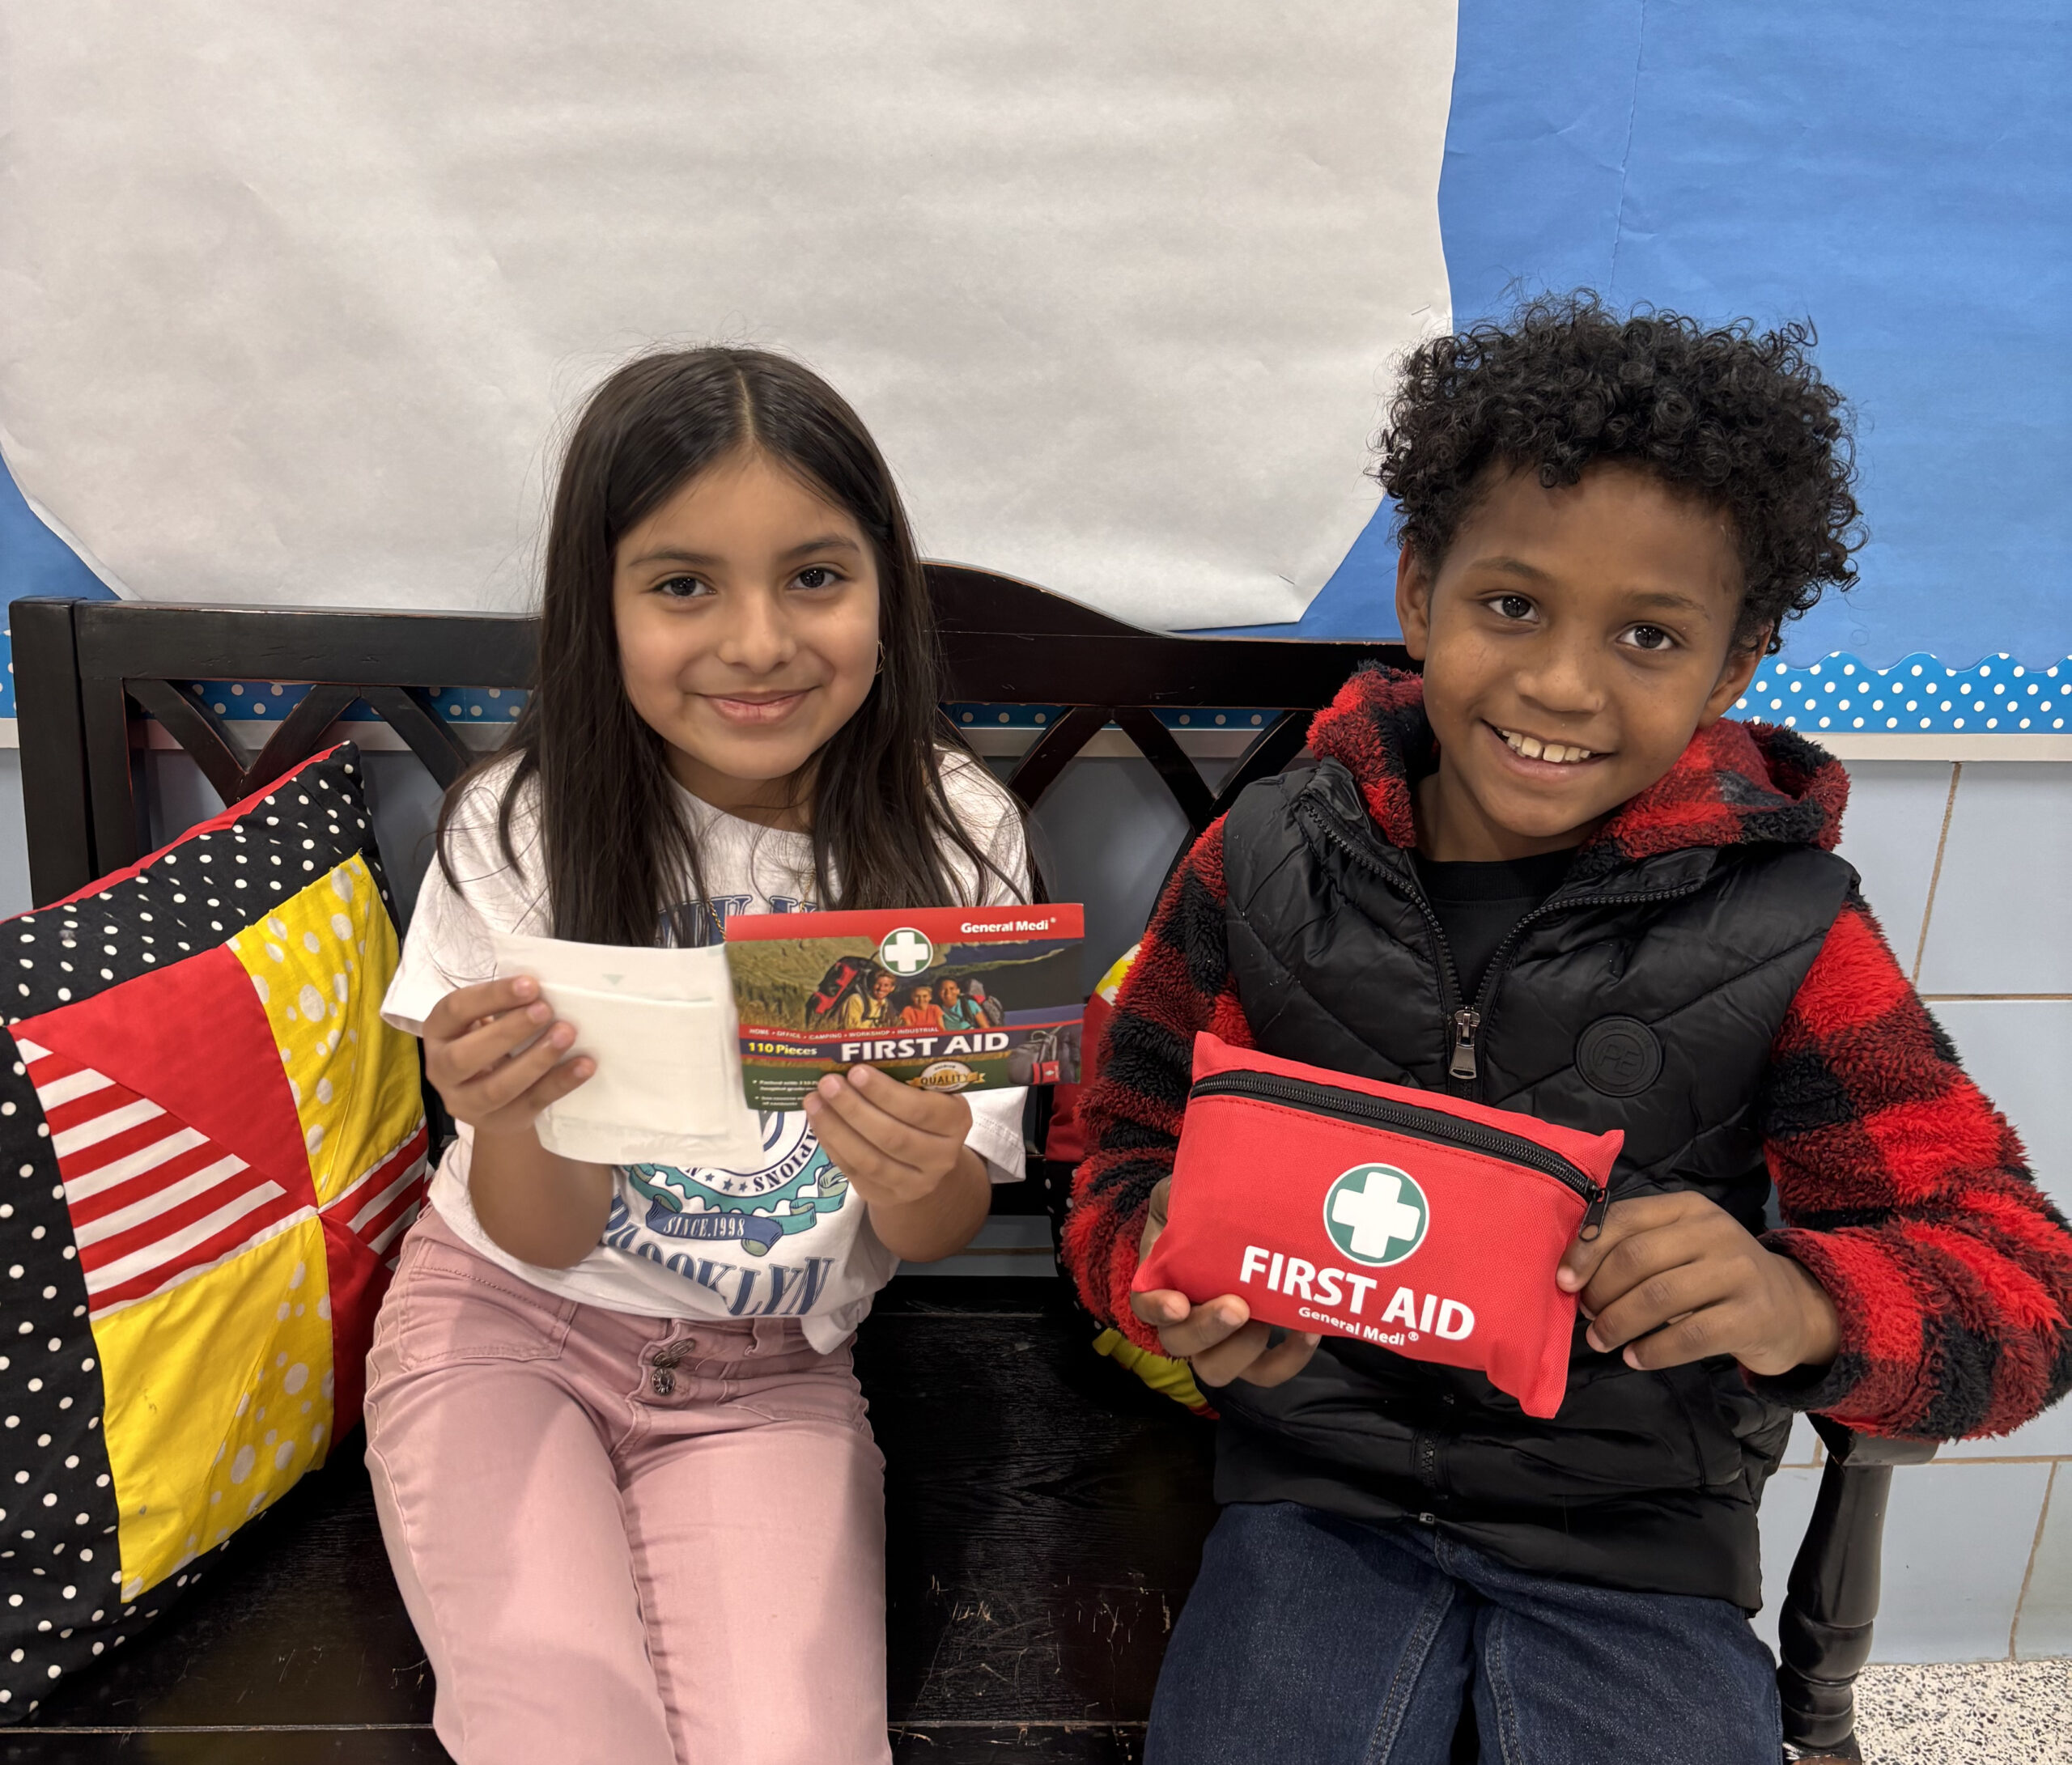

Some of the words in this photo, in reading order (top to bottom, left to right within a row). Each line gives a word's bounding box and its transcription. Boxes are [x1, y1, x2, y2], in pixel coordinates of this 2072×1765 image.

[961, 921, 1013, 933] General
[776, 1030, 800, 1039] OFFICE
[848, 1029, 890, 1037] WORKSHOP
[897, 1026, 940, 1034] INDUSTRIAL
[749, 1042, 774, 1053] 110
[775, 1043, 818, 1055] Pieces
[842, 1037, 939, 1062] FIRST
[943, 1032, 1009, 1054] AID
[920, 1073, 970, 1086] QUALITY
[1239, 1245, 1378, 1315] FIRST
[1381, 1286, 1475, 1341] AID
[1298, 1306, 1361, 1335] General
